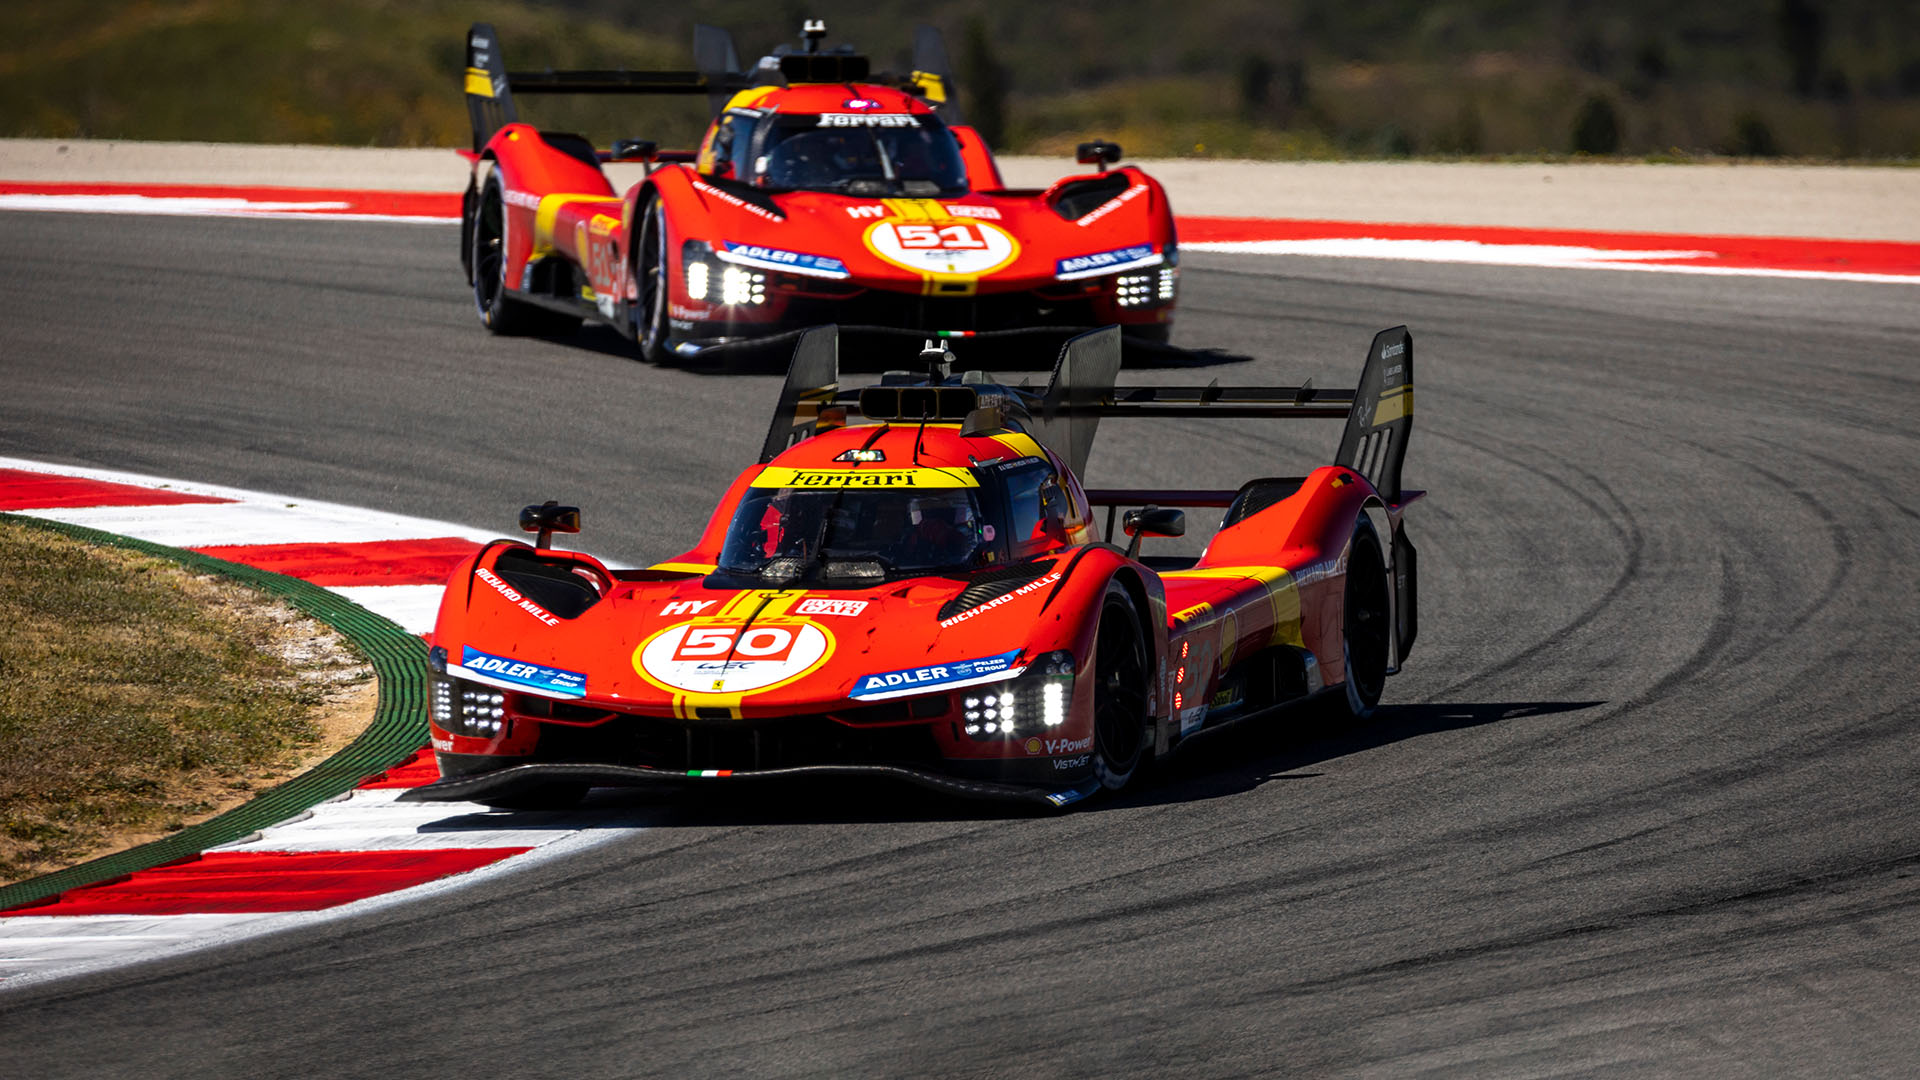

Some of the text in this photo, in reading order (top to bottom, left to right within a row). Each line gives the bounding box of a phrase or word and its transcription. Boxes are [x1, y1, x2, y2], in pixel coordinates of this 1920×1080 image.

[816, 112, 921, 128] Ferrari
[846, 205, 884, 219] HY
[896, 225, 985, 247] 51
[731, 245, 798, 264] ADLER
[785, 470, 918, 486] Ferrari
[475, 567, 559, 627] RICHARD MILLE
[941, 572, 1061, 628] RICHARD MILLE
[659, 600, 718, 616] HY
[801, 605, 857, 614] CAR
[679, 628, 792, 656] 50
[464, 656, 538, 679] ADLER
[973, 658, 1005, 667] PELZER
[865, 667, 950, 689] ADLER
[1045, 736, 1091, 754] V-Power
